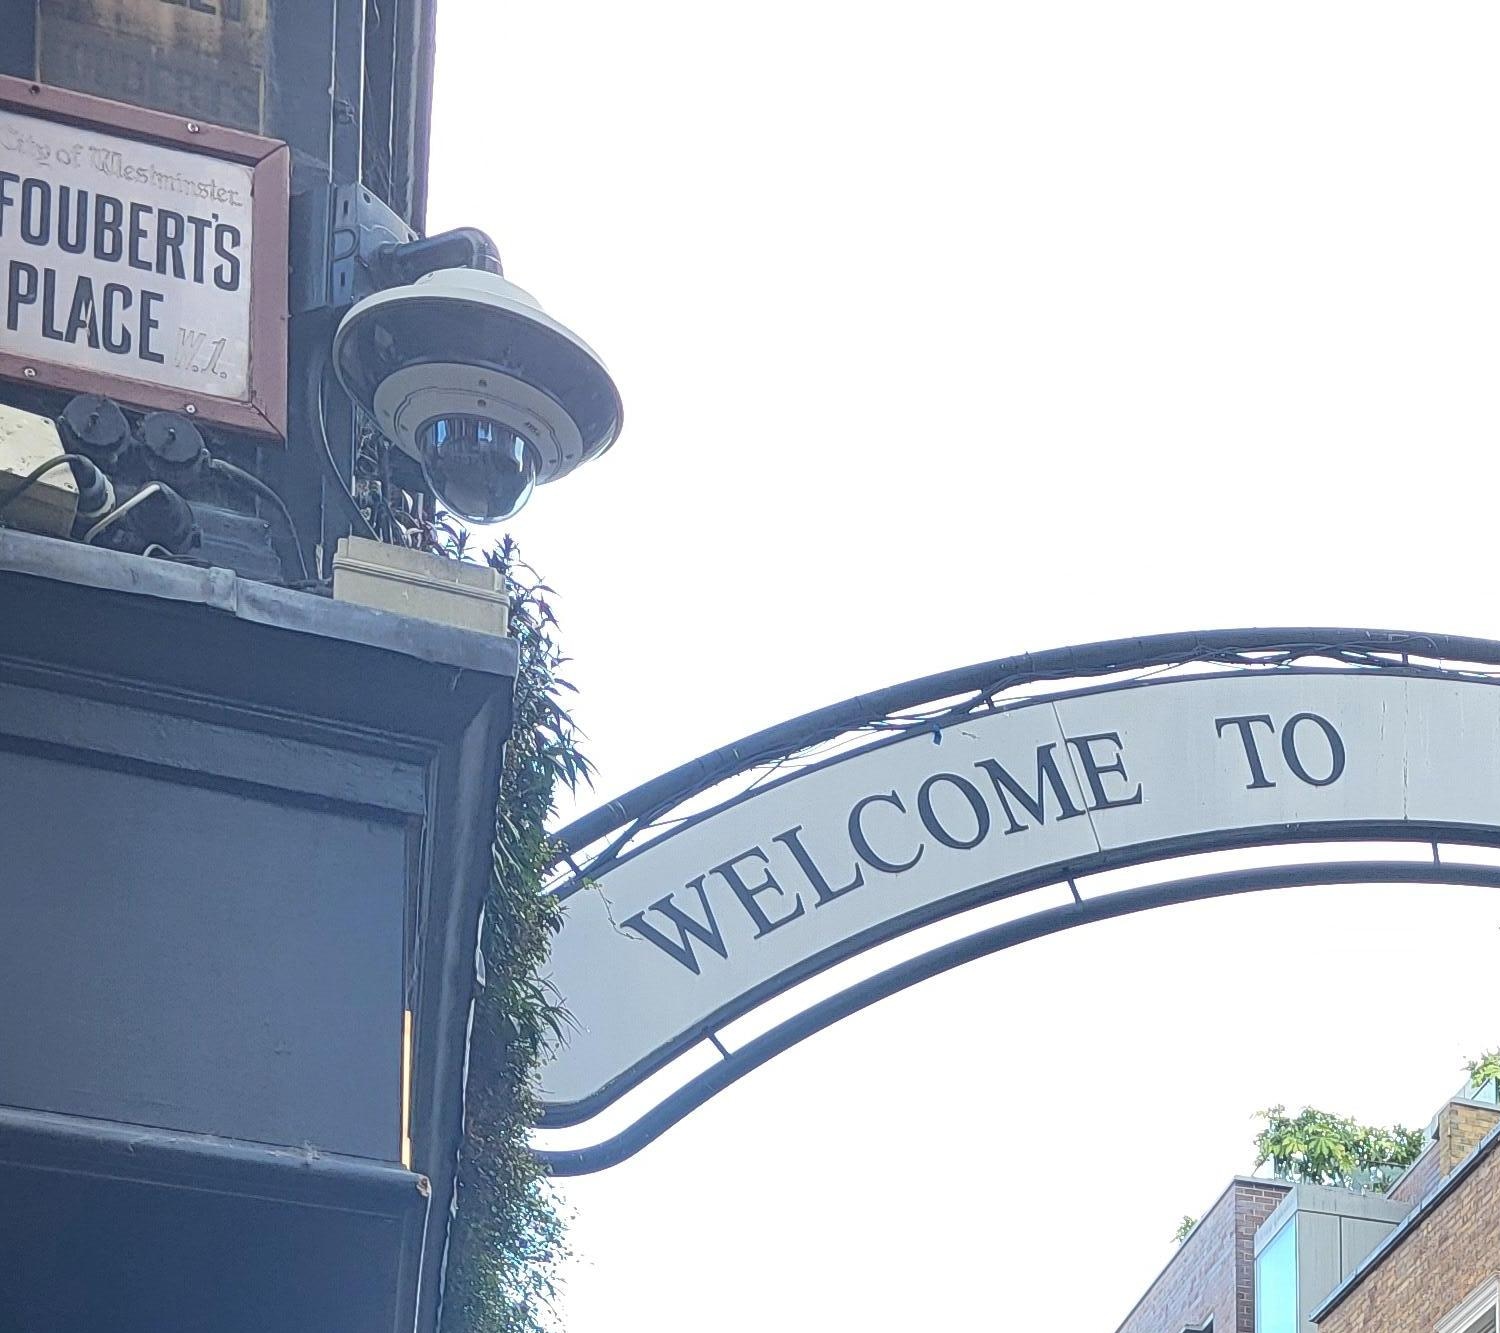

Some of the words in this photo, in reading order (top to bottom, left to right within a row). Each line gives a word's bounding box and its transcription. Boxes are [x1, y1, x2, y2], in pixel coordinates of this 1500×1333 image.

[0, 170, 241, 292] FOUBERT'S
[88, 145, 243, 207] Westminster
[7, 260, 164, 364] PLACE
[620, 731, 1142, 976] WELCOME
[1214, 712, 1346, 790] TO
